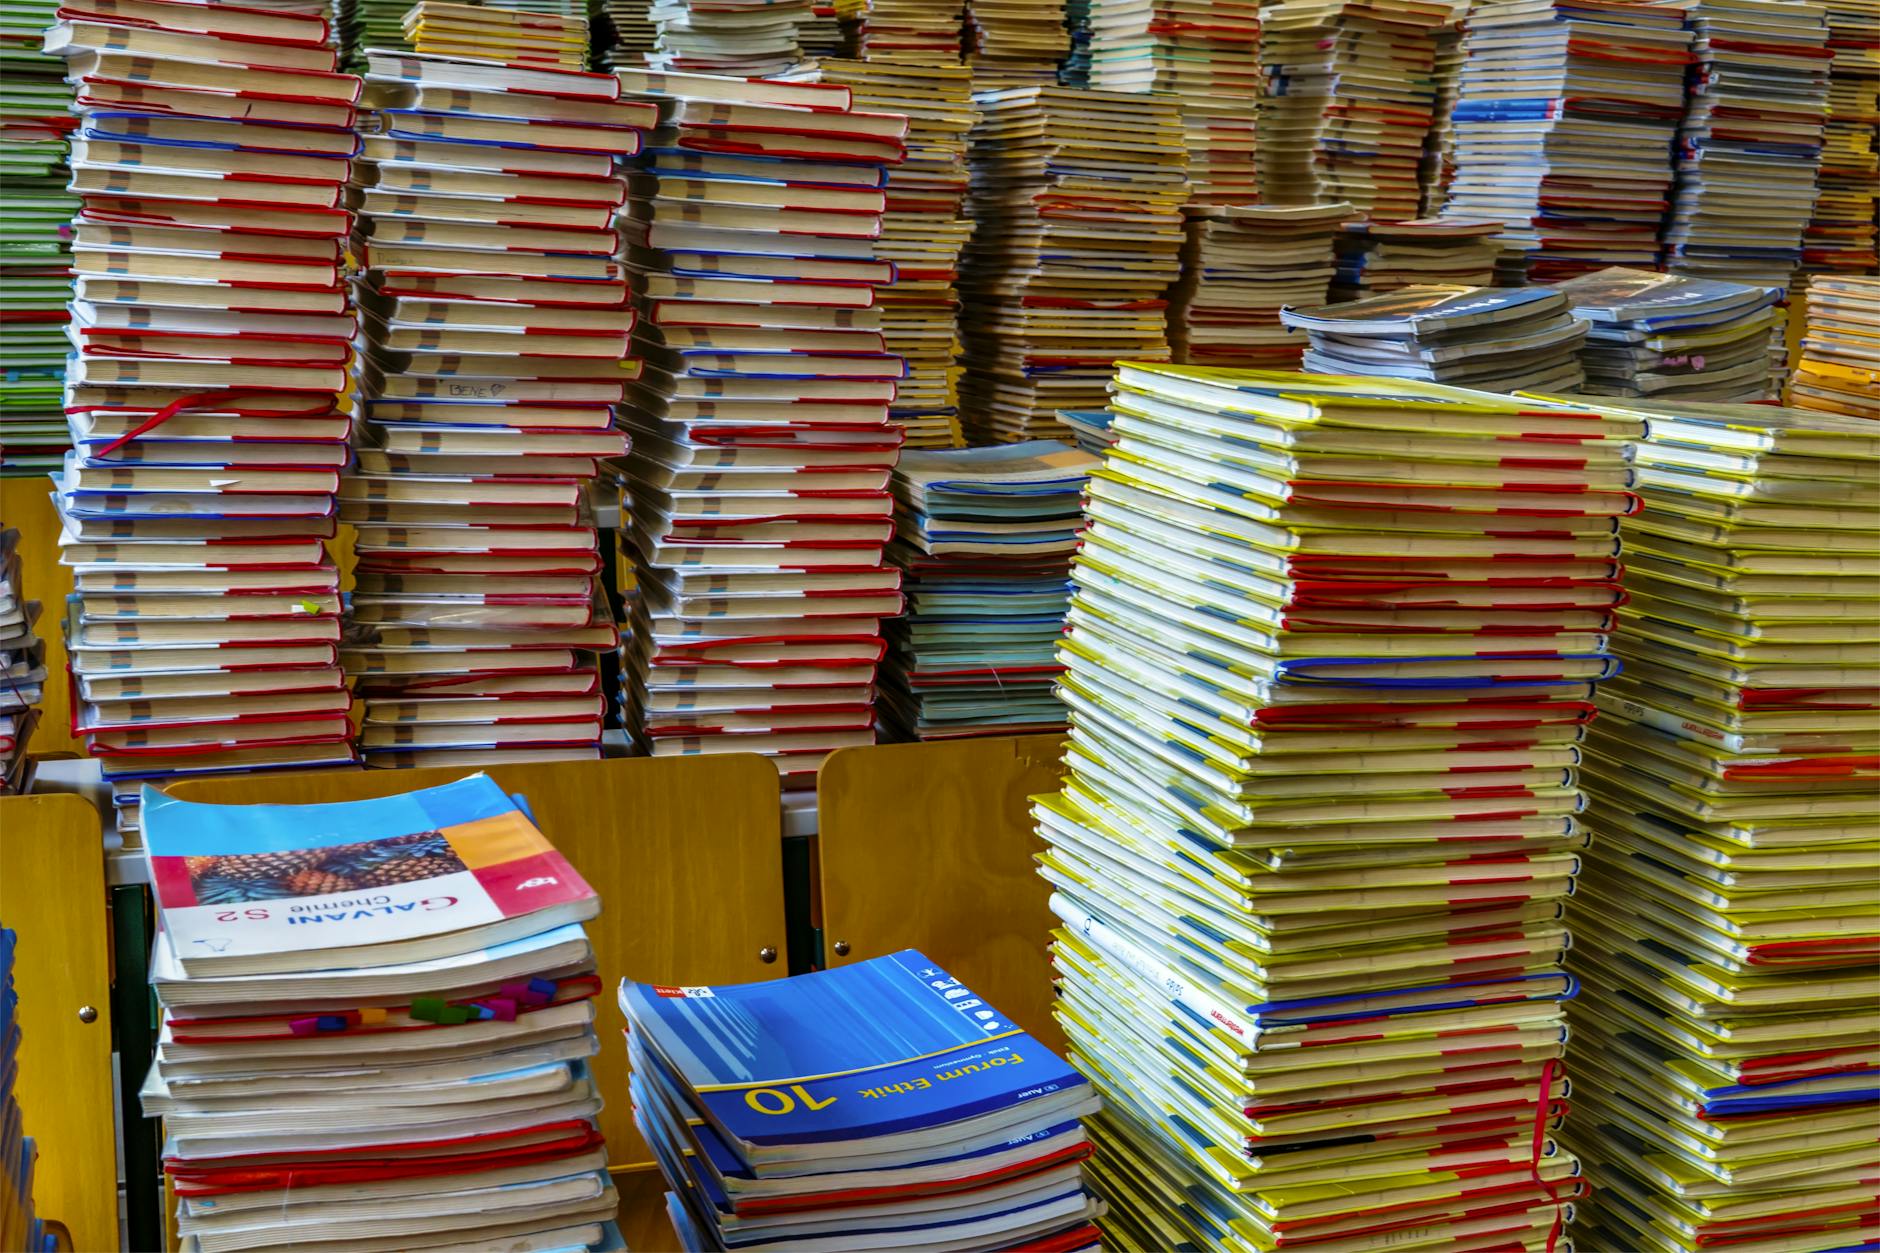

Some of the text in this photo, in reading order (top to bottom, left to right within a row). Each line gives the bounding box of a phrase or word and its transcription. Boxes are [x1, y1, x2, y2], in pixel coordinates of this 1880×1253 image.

[449, 383, 486, 398] BENE
[289, 894, 391, 914] Chemie
[857, 1052, 1026, 1099] Forum Ethik
[745, 1083, 838, 1116] 10
[1016, 1086, 1043, 1100] Auer
[1007, 1133, 1034, 1147] Auer
